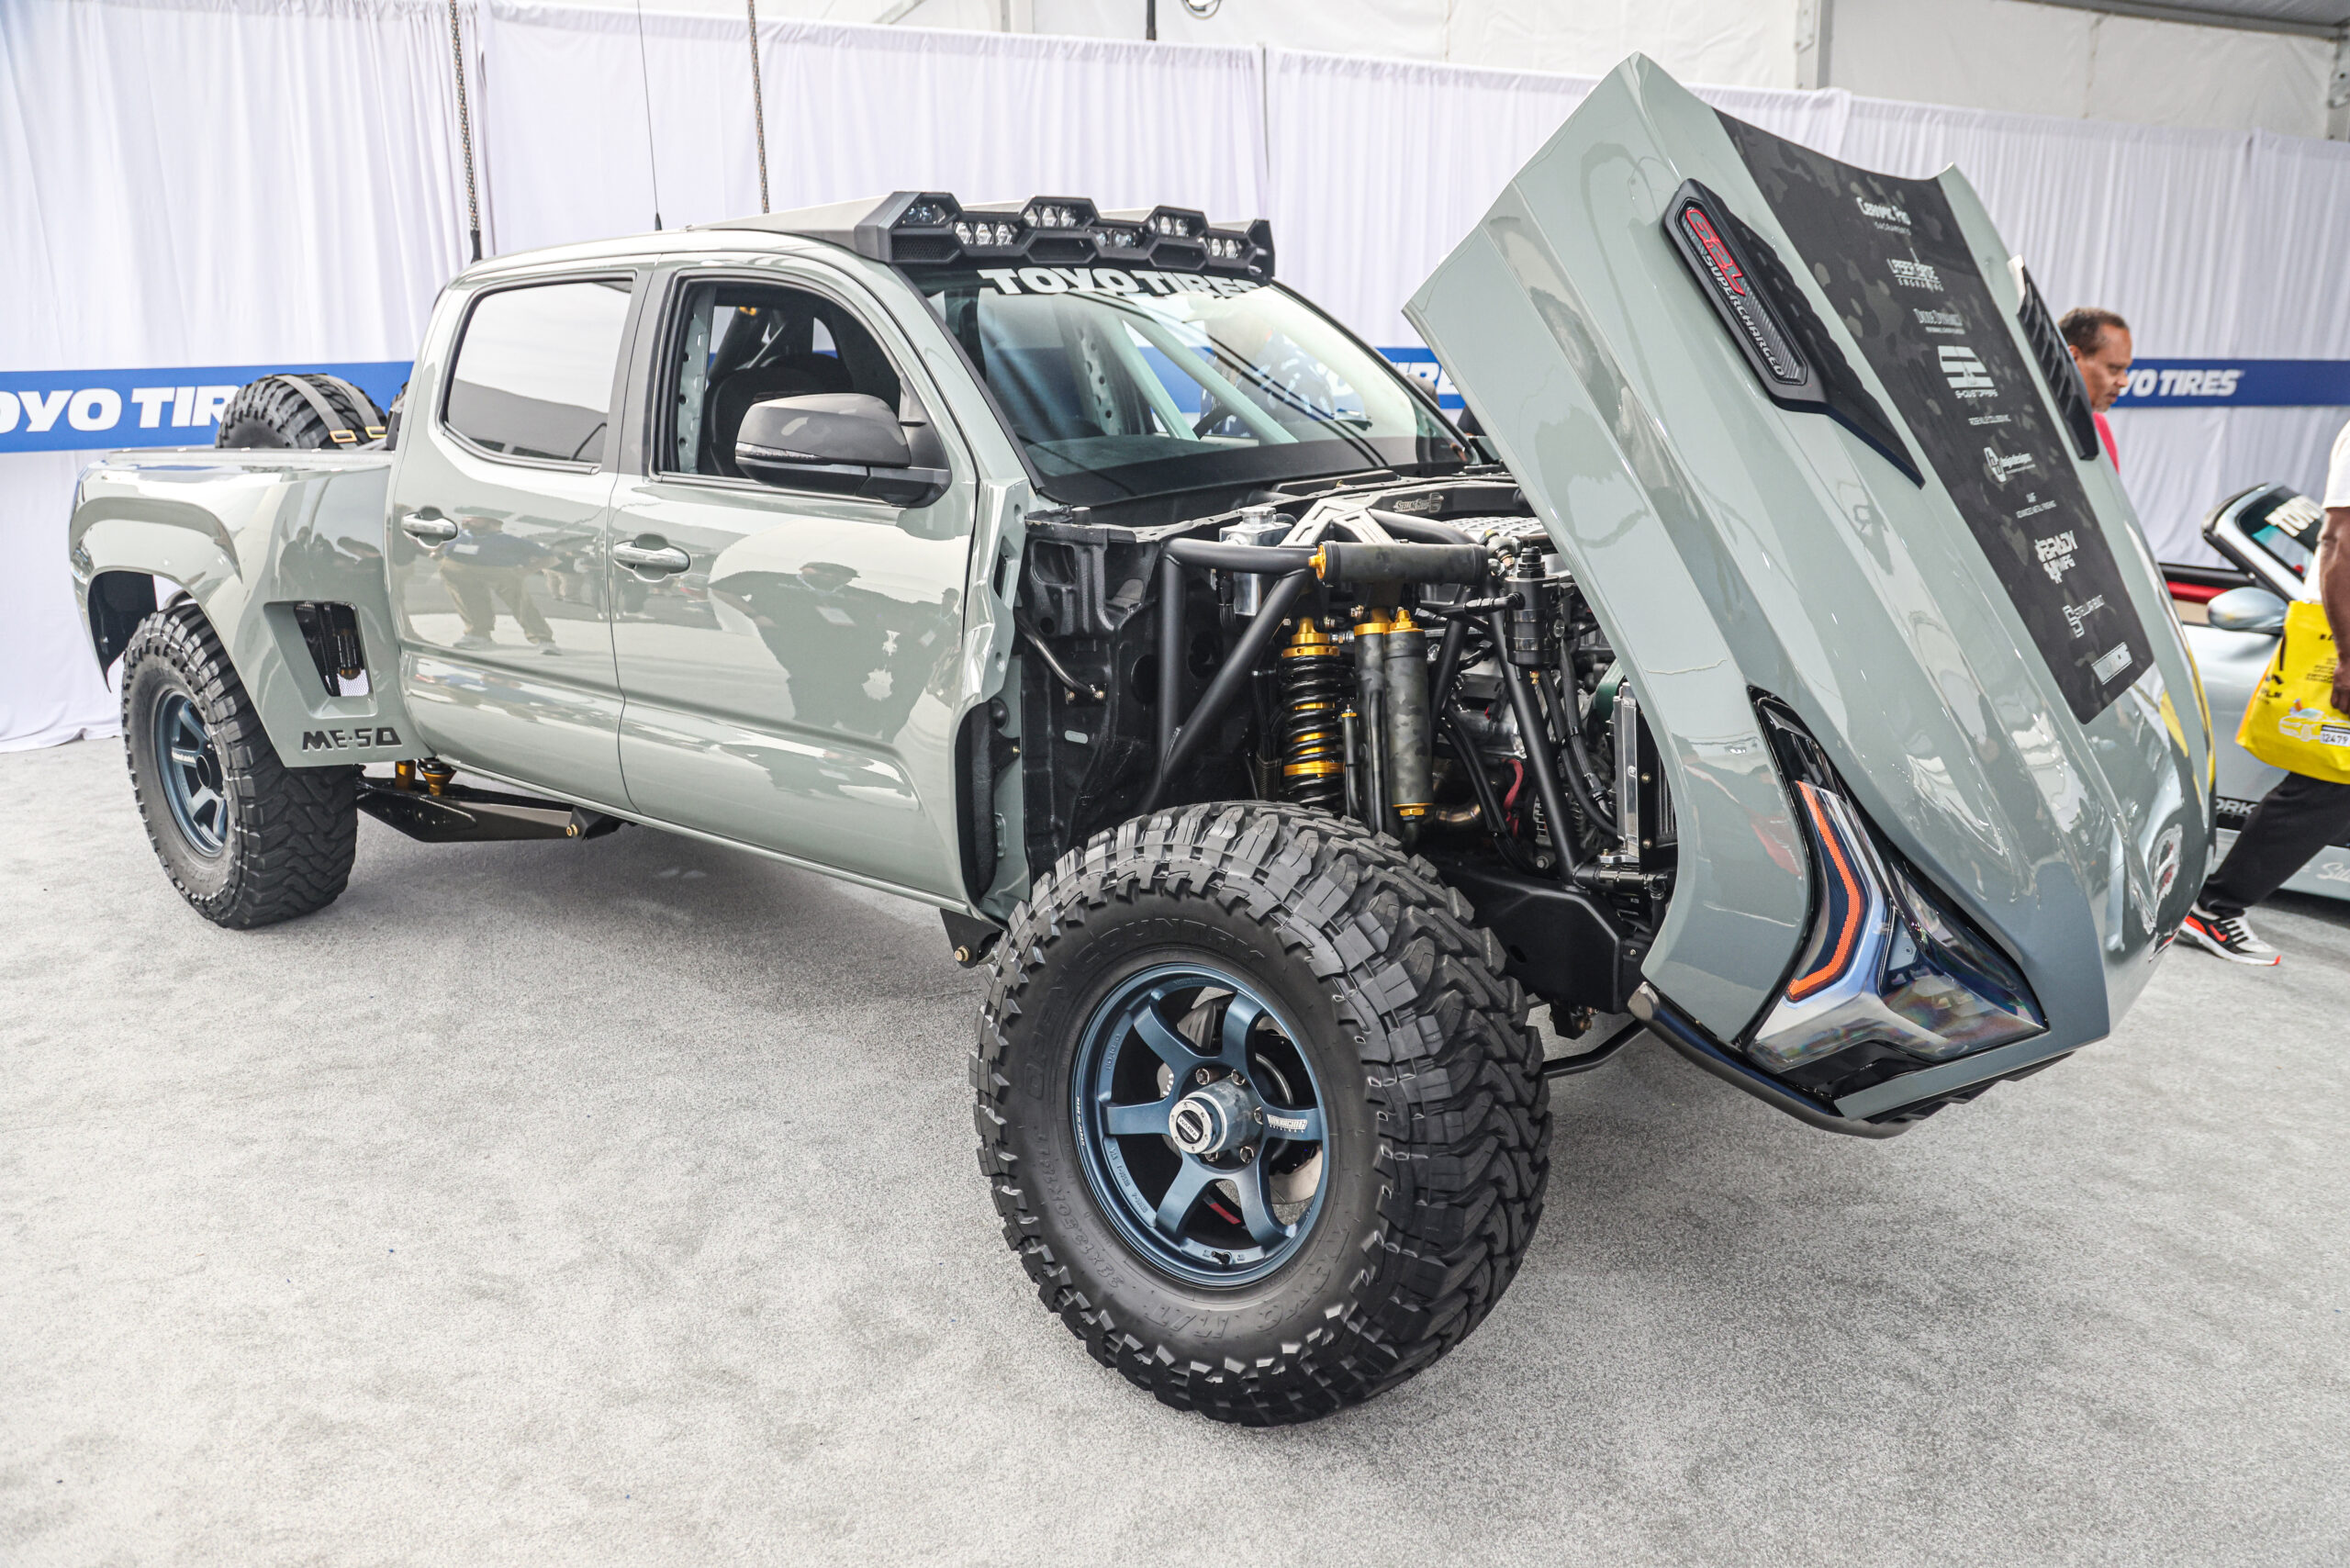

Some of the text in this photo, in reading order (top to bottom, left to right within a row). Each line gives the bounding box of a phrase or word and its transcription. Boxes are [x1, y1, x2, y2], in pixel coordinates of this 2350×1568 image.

[978, 267, 1261, 299] TOYO TIRES
[1704, 254, 1785, 376] SUPERCHARGED
[2159, 369, 2242, 397] TIRES
